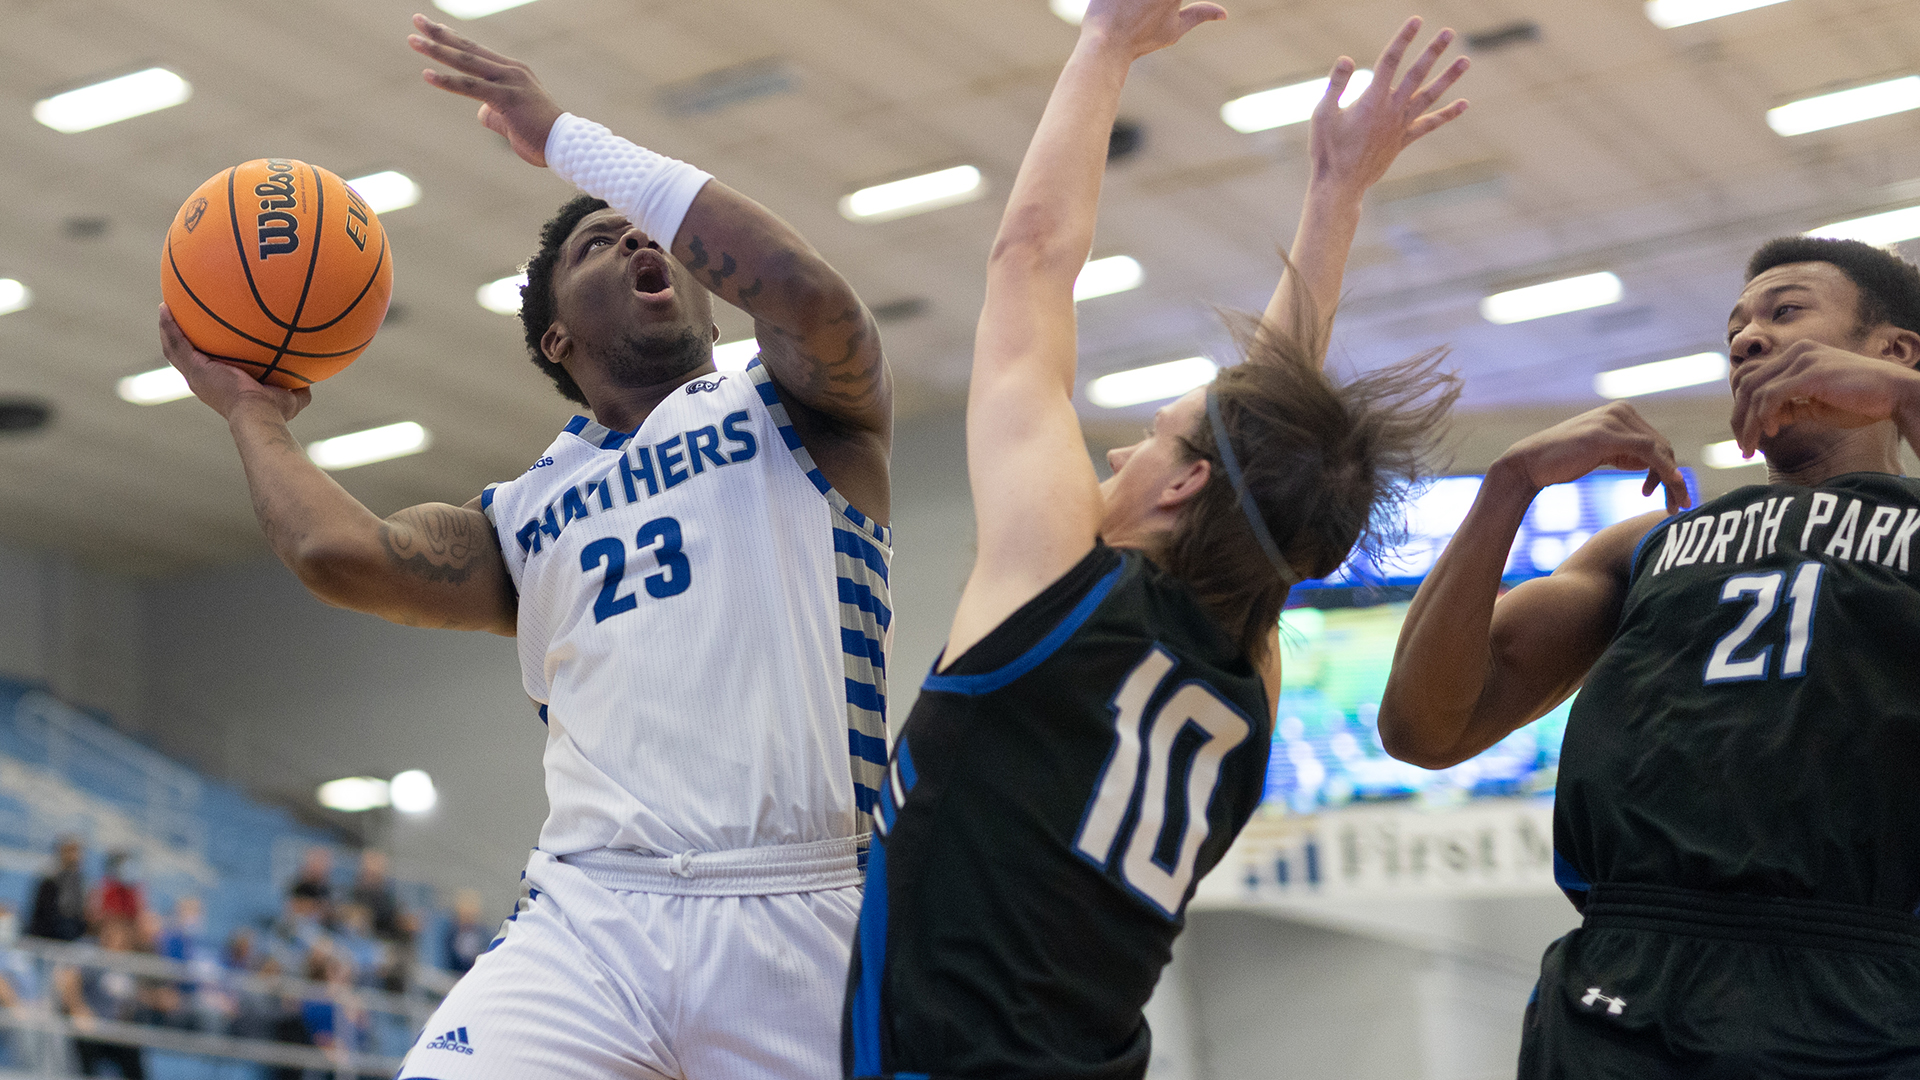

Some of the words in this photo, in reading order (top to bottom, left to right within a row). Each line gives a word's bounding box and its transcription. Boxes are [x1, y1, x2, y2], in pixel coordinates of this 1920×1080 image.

[579, 516, 692, 625] 23
[1652, 496, 1795, 577] NORTH
[1800, 492, 1920, 573] PARK
[1703, 560, 1826, 686] 21
[1071, 640, 1256, 922] 10
[1340, 820, 1497, 880] First
[426, 1040, 474, 1056] adidas
